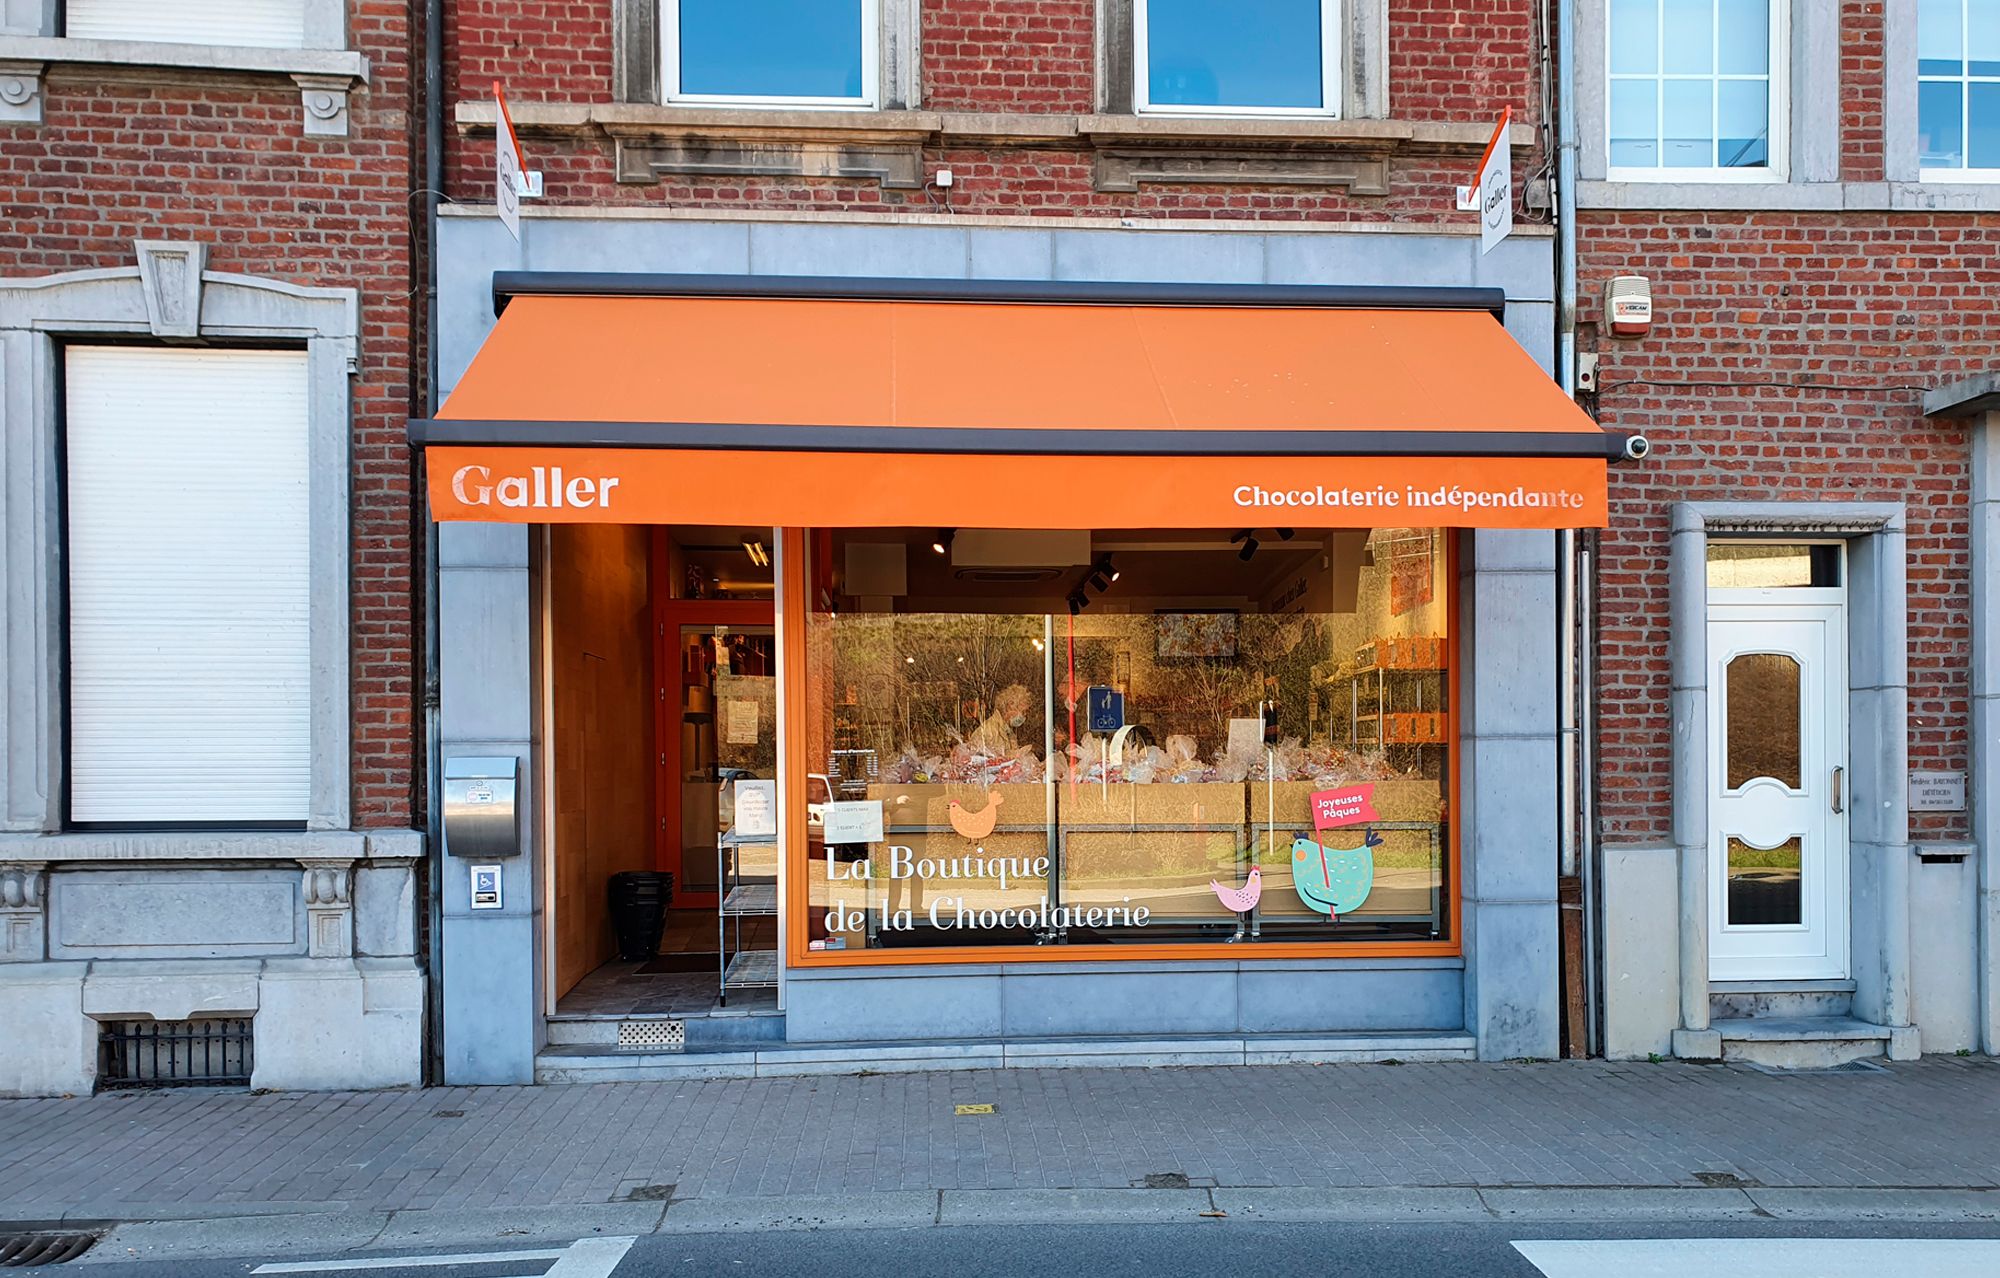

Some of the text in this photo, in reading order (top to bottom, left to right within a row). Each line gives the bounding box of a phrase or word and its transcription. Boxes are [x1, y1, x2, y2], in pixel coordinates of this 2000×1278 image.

[451, 464, 620, 509] Galler
[1233, 485, 1585, 513] Chocolaterie indépendante
[1317, 794, 1364, 809] Joyeuses
[1322, 806, 1361, 819] Pâques
[824, 845, 1050, 890] La Boutique
[824, 895, 1151, 932] de la Chocolaterie
